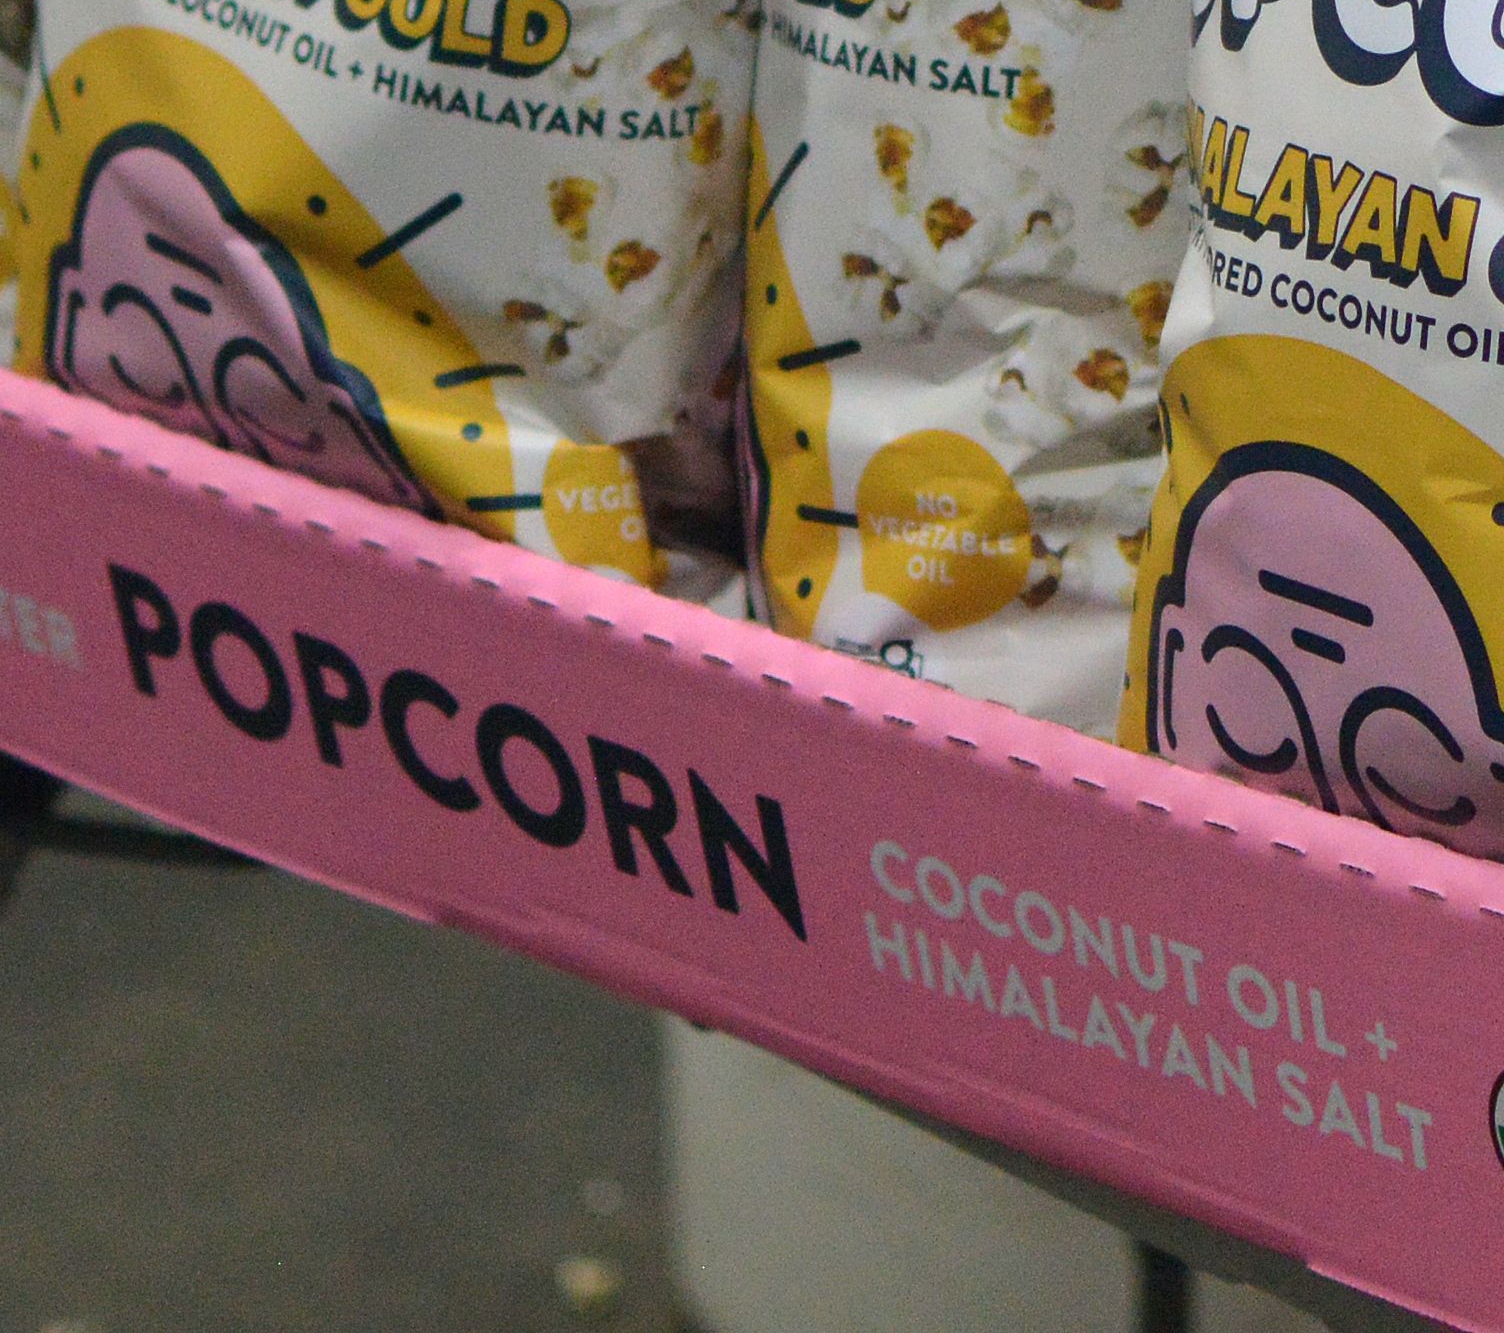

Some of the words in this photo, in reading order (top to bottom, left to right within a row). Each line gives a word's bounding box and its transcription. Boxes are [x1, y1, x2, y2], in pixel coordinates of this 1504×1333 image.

[293, 32, 340, 79] OIL
[372, 64, 606, 139] HIMALAYAN
[617, 107, 700, 141] SALT
[771, 19, 917, 88] HIMALAYAN
[929, 59, 1022, 102] SALT
[1191, 99, 1482, 300] ALAYAN
[1269, 271, 1437, 351] COCONUT
[868, 514, 1016, 556] VEGETABLE
[915, 490, 959, 520] NO
[906, 554, 956, 586] OIL
[108, 561, 810, 943] POPCORN
[867, 840, 1205, 1007] COCONUT
[1224, 964, 1348, 1059] OIL
[1362, 1019, 1399, 1062] +
[863, 911, 1260, 1110] HIMALAYAN
[1275, 1062, 1434, 1171] SALT
